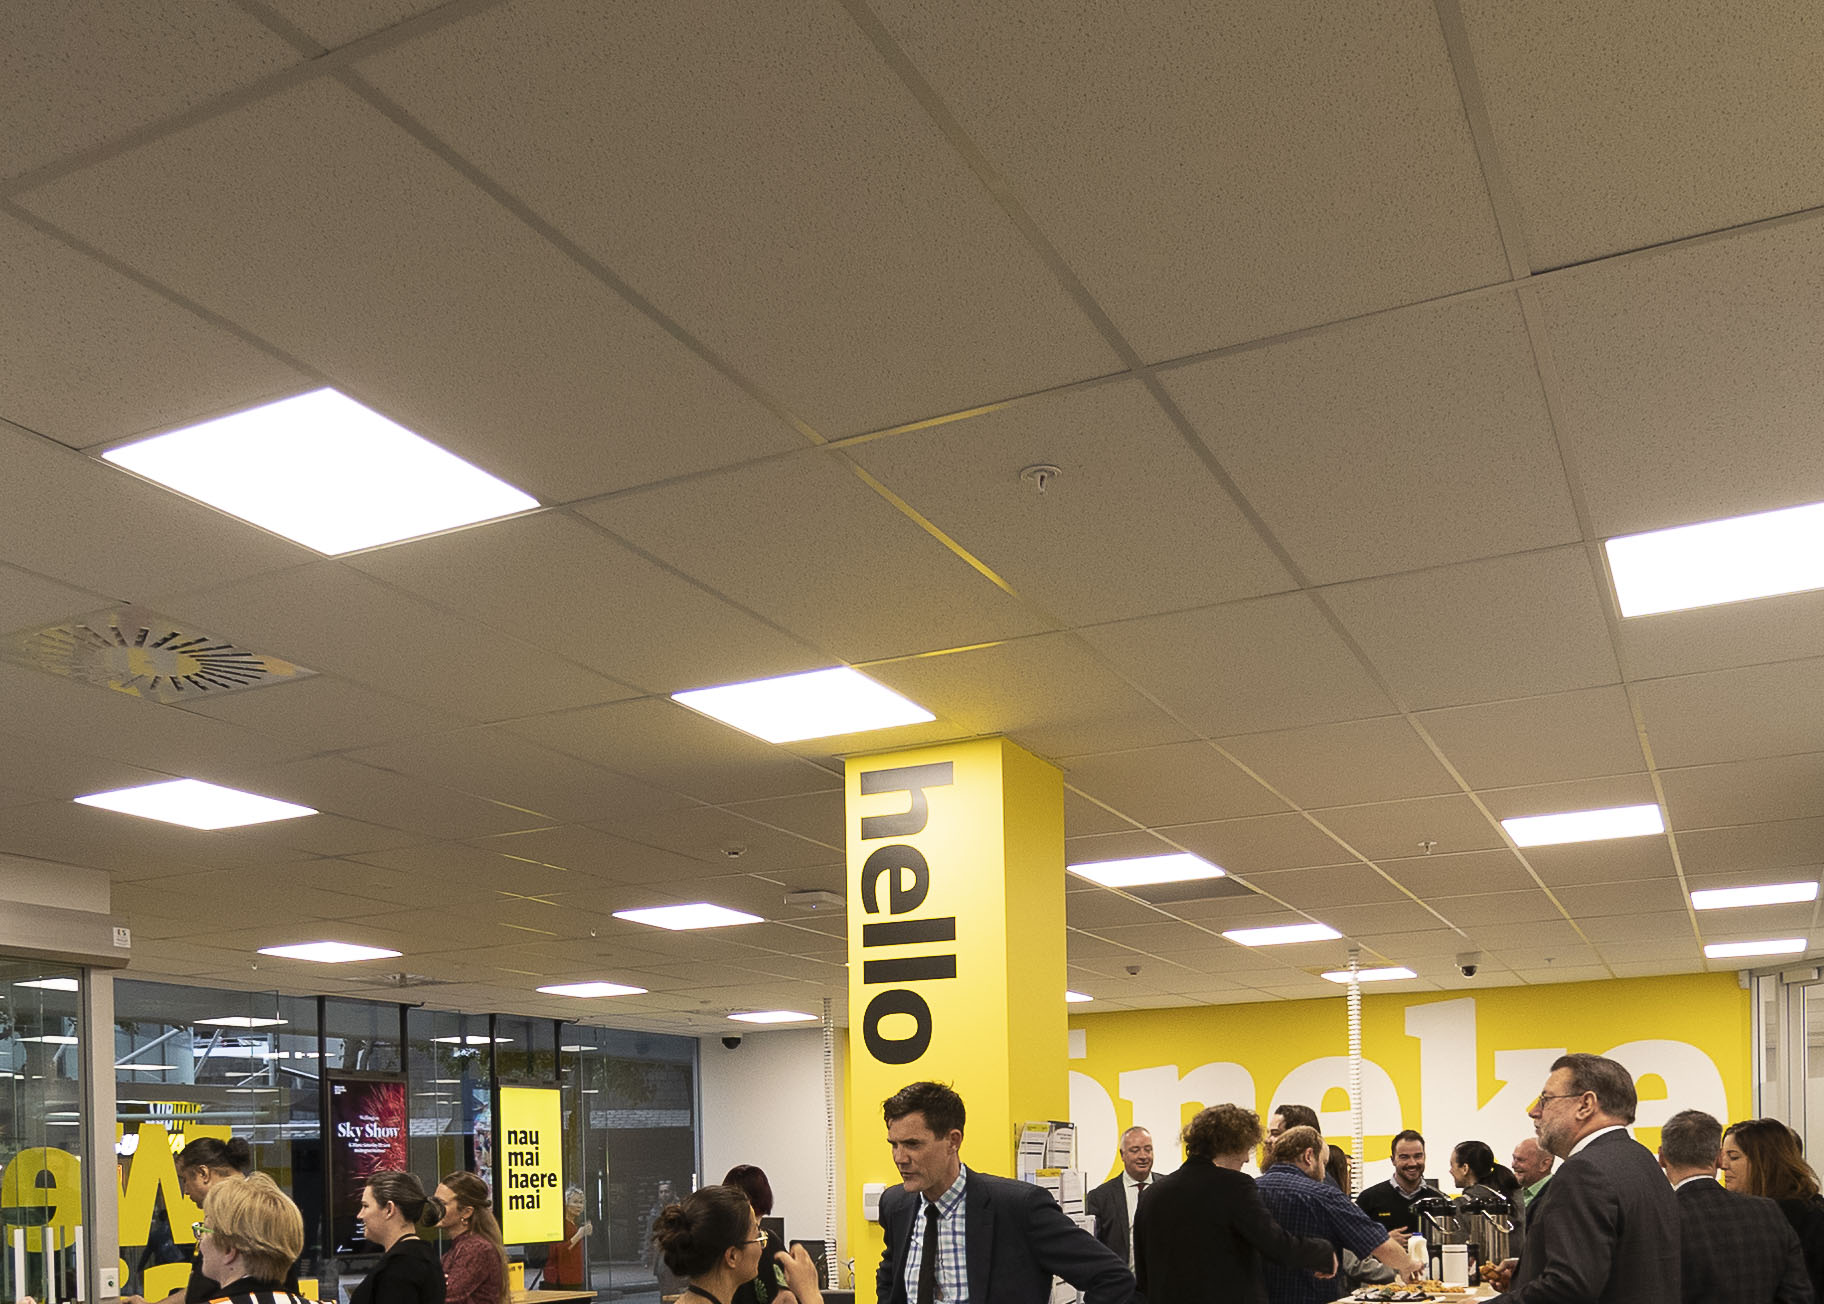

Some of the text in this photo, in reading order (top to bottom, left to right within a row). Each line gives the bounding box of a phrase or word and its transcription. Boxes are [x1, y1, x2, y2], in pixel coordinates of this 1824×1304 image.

[860, 761, 957, 1065] hello
[337, 1121, 401, 1142] Sky Show
[507, 1129, 539, 1145] nau
[508, 1147, 540, 1166] mai
[508, 1168, 558, 1189] haere
[509, 1189, 541, 1210] mai
